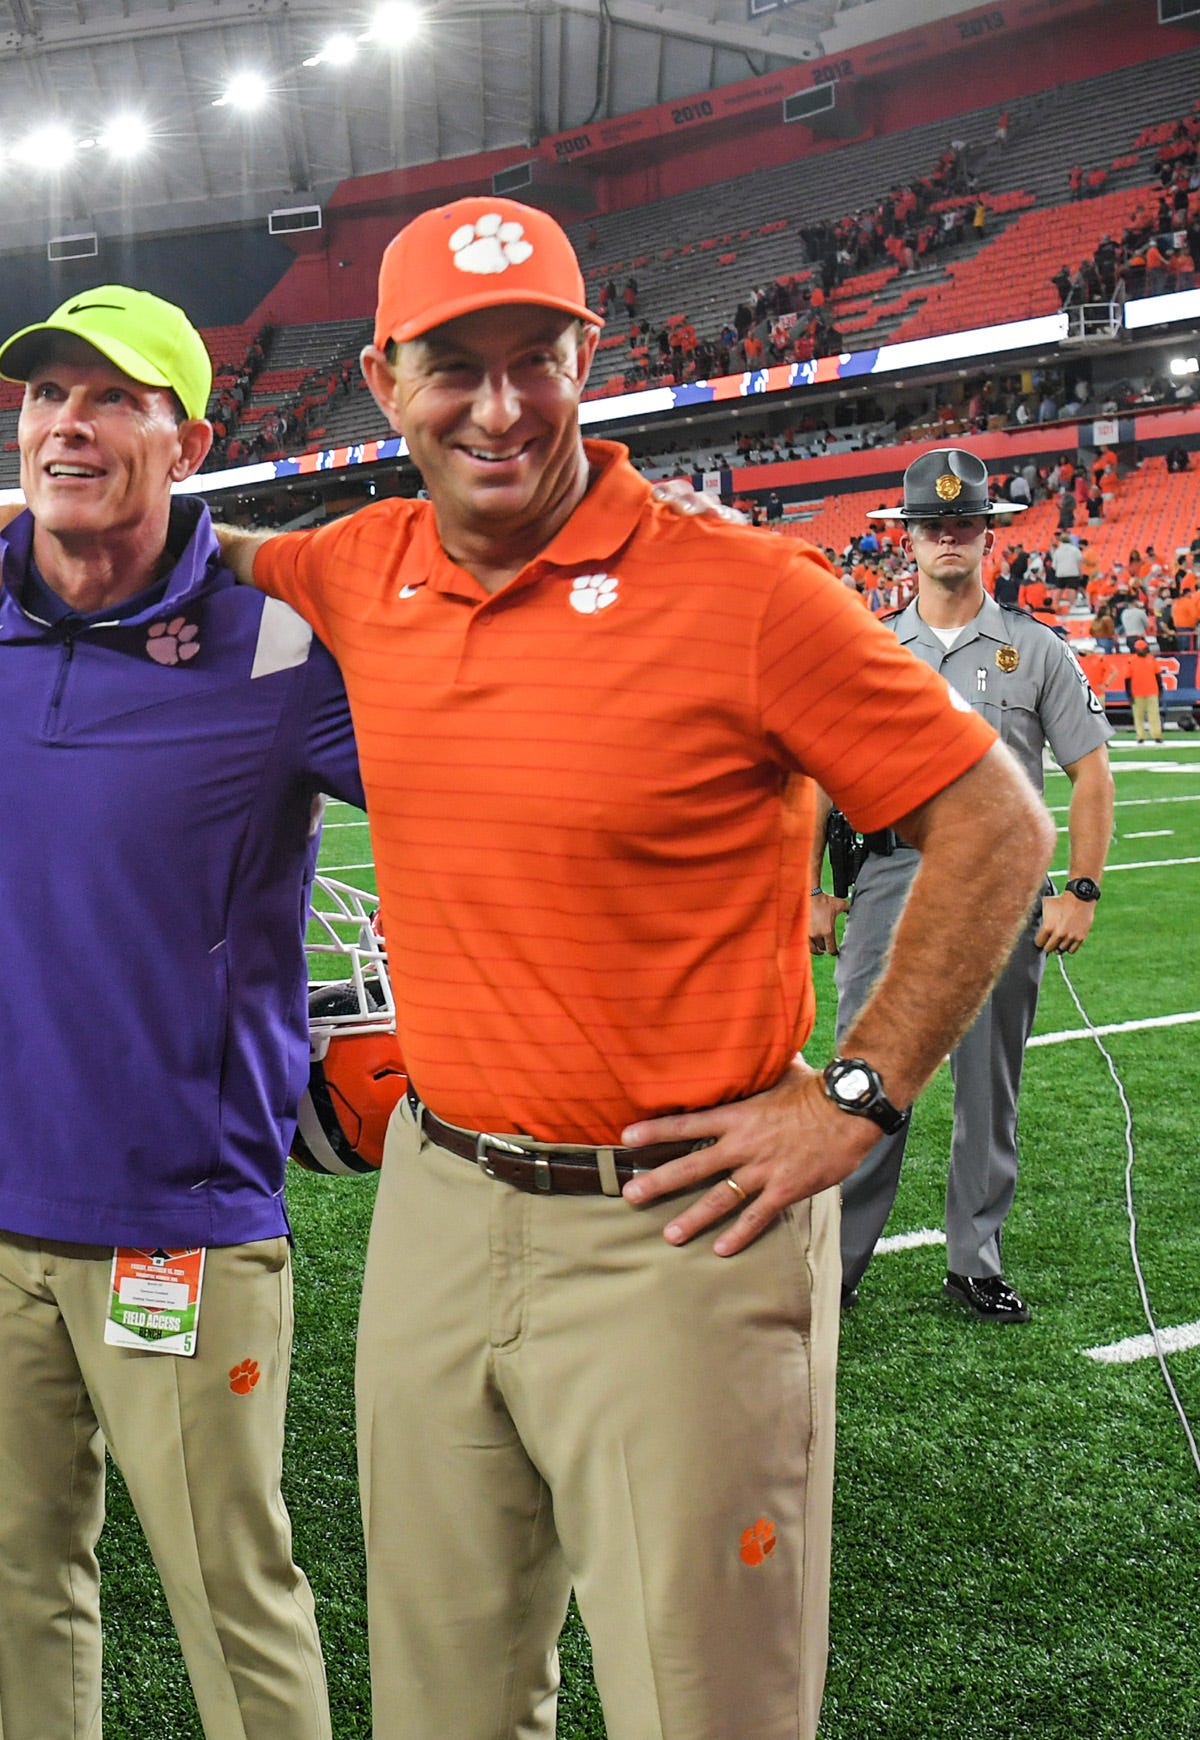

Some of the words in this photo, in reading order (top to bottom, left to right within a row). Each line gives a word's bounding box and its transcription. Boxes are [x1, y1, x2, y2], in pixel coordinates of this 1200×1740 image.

[671, 101, 714, 125] 2010
[554, 134, 592, 156] 2001
[123, 1311, 146, 1326] FIELD
[146, 1314, 181, 1331] ACCESS
[184, 1335, 192, 1352] 5
